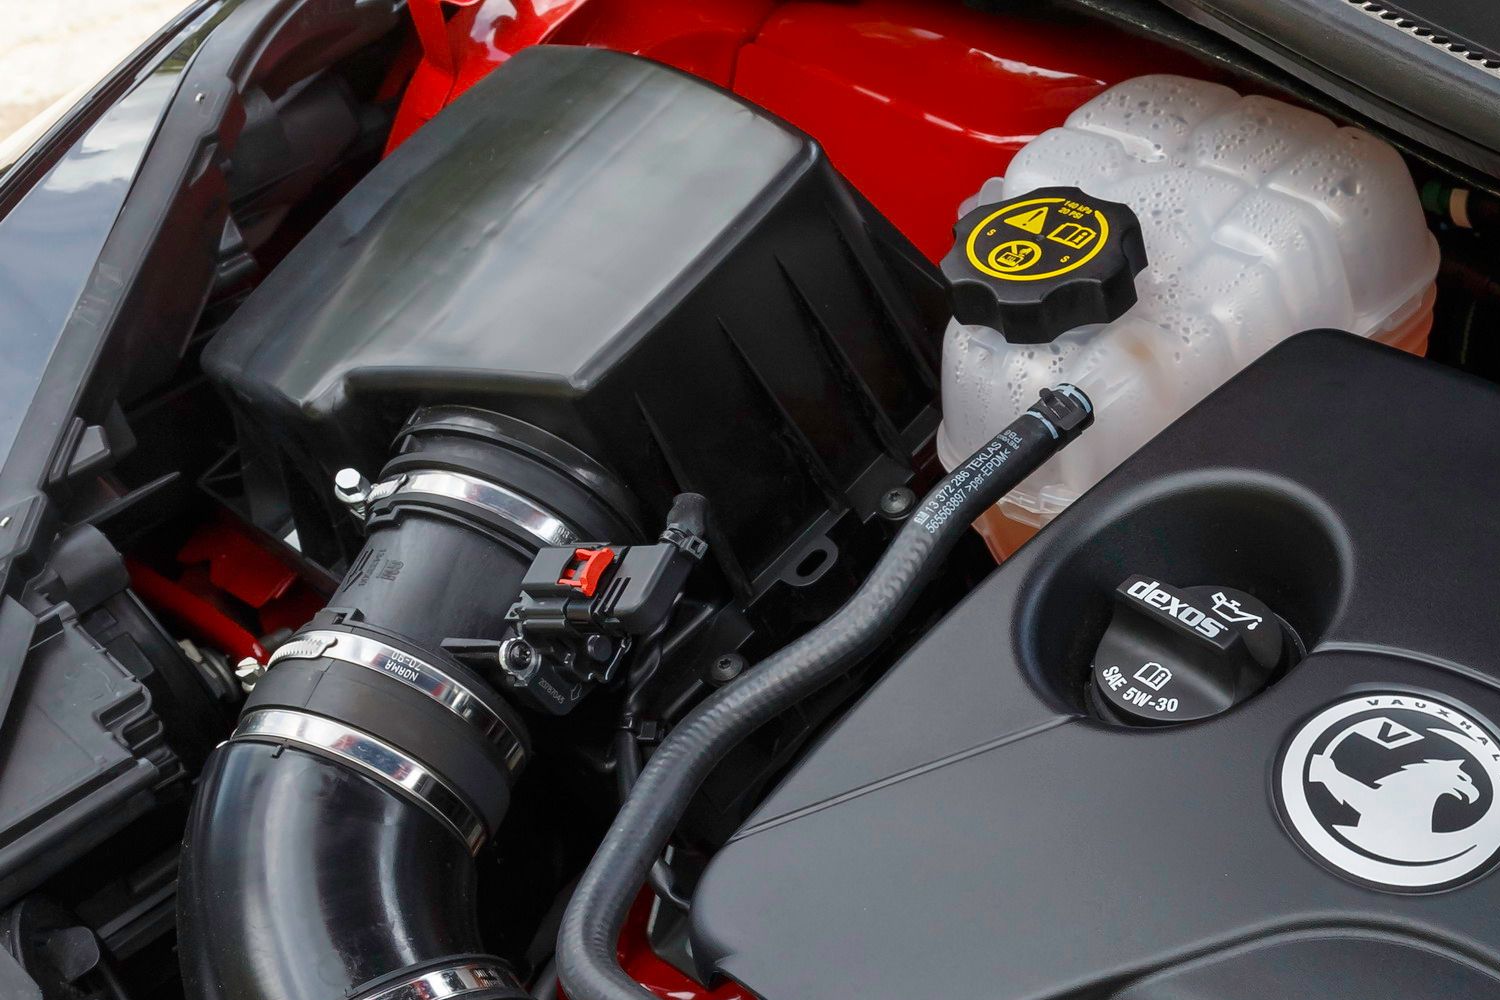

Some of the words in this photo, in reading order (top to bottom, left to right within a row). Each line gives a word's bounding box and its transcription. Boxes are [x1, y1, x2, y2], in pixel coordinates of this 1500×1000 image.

[1068, 210, 1084, 219] PSI
[925, 500, 939, 513] 13
[935, 484, 955, 502] 372
[950, 470, 970, 487] 286
[965, 441, 1002, 471] TEKLAS
[925, 488, 967, 534] 565563897
[1126, 580, 1226, 639] dexos
[384, 659, 419, 682] NORMA
[391, 651, 422, 671] 70-90
[1102, 665, 1128, 692] SAE
[1122, 686, 1179, 713] 5W-30
[1377, 721, 1413, 744] V
